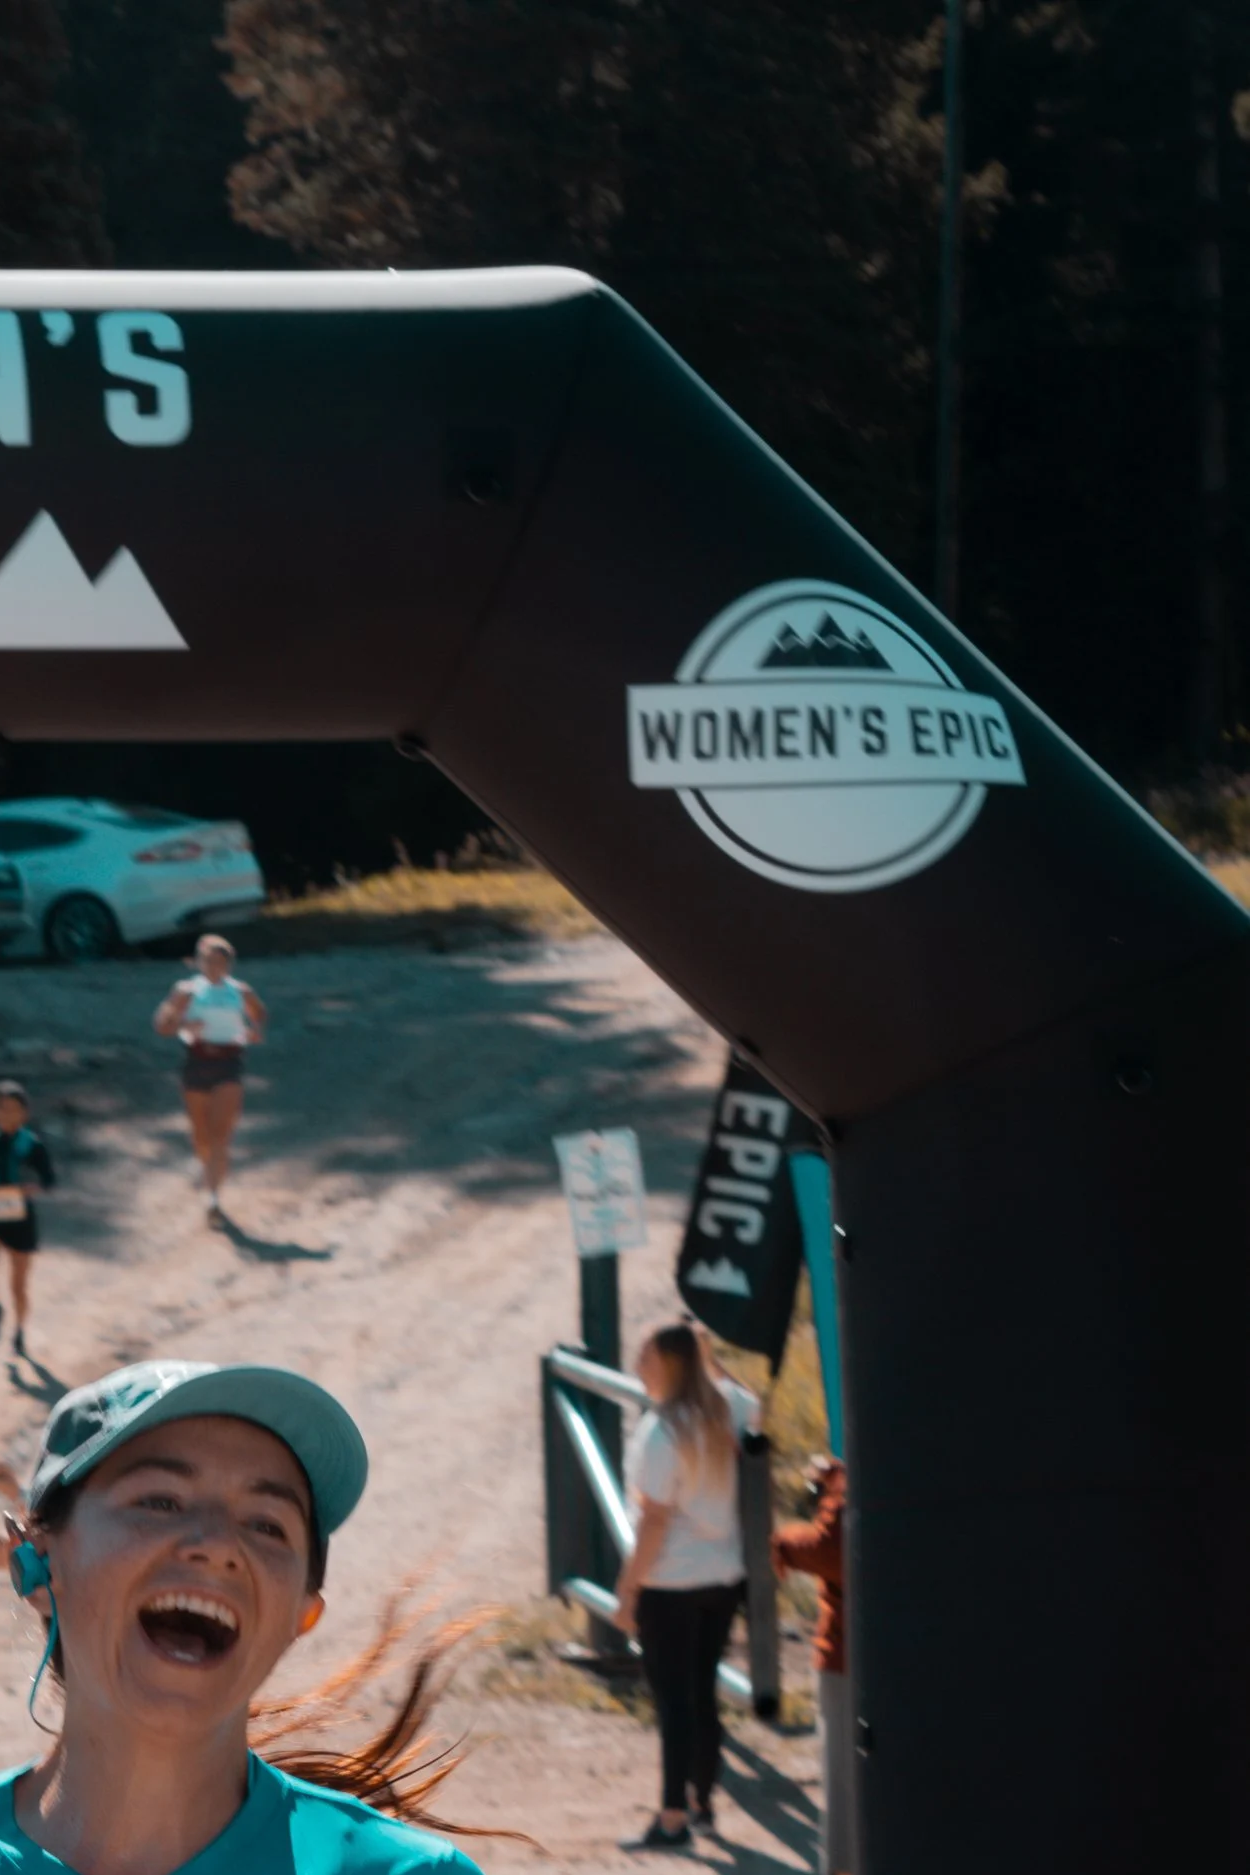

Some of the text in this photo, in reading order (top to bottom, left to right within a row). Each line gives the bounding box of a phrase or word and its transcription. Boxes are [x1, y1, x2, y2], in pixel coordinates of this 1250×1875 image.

[639, 704, 1012, 763] WOMEN'S EPIC
[696, 1089, 790, 1246] EPIC
